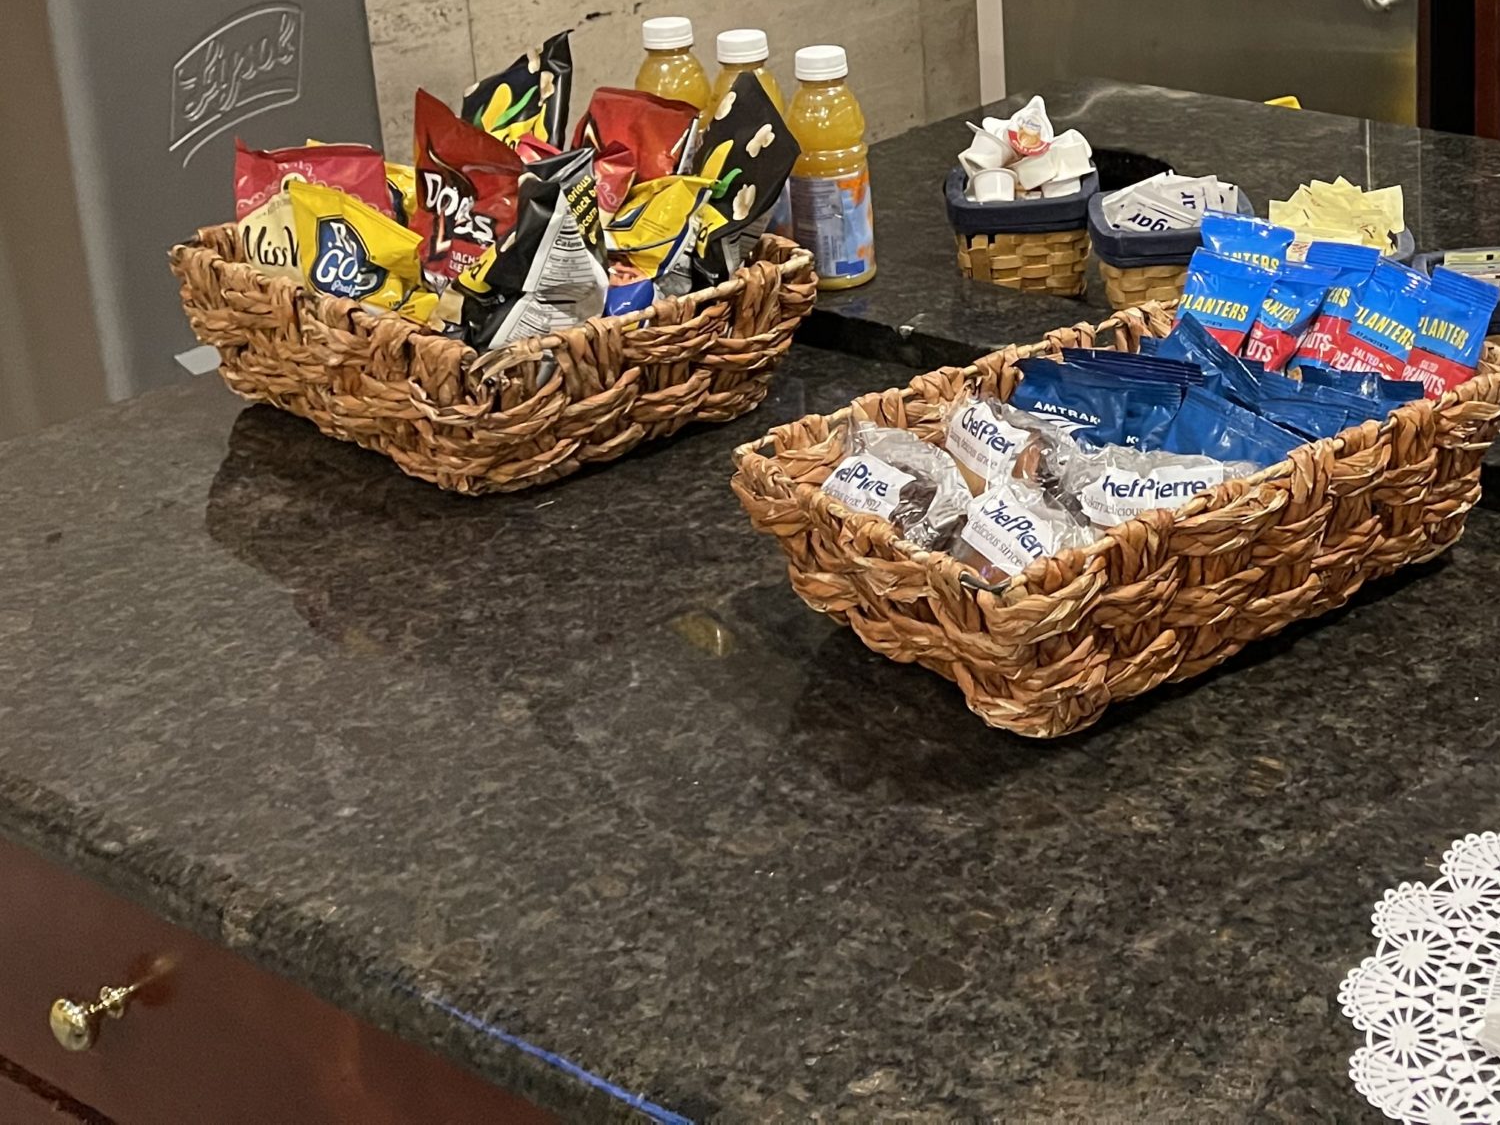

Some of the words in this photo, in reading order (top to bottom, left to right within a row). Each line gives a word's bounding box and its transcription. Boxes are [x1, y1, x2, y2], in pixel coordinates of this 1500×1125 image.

[1180, 293, 1249, 322] PLANTERS
[1351, 346, 1379, 366] SALTED
[1033, 401, 1098, 424] AMTRAK
[1102, 475, 1207, 500] hefPierre
